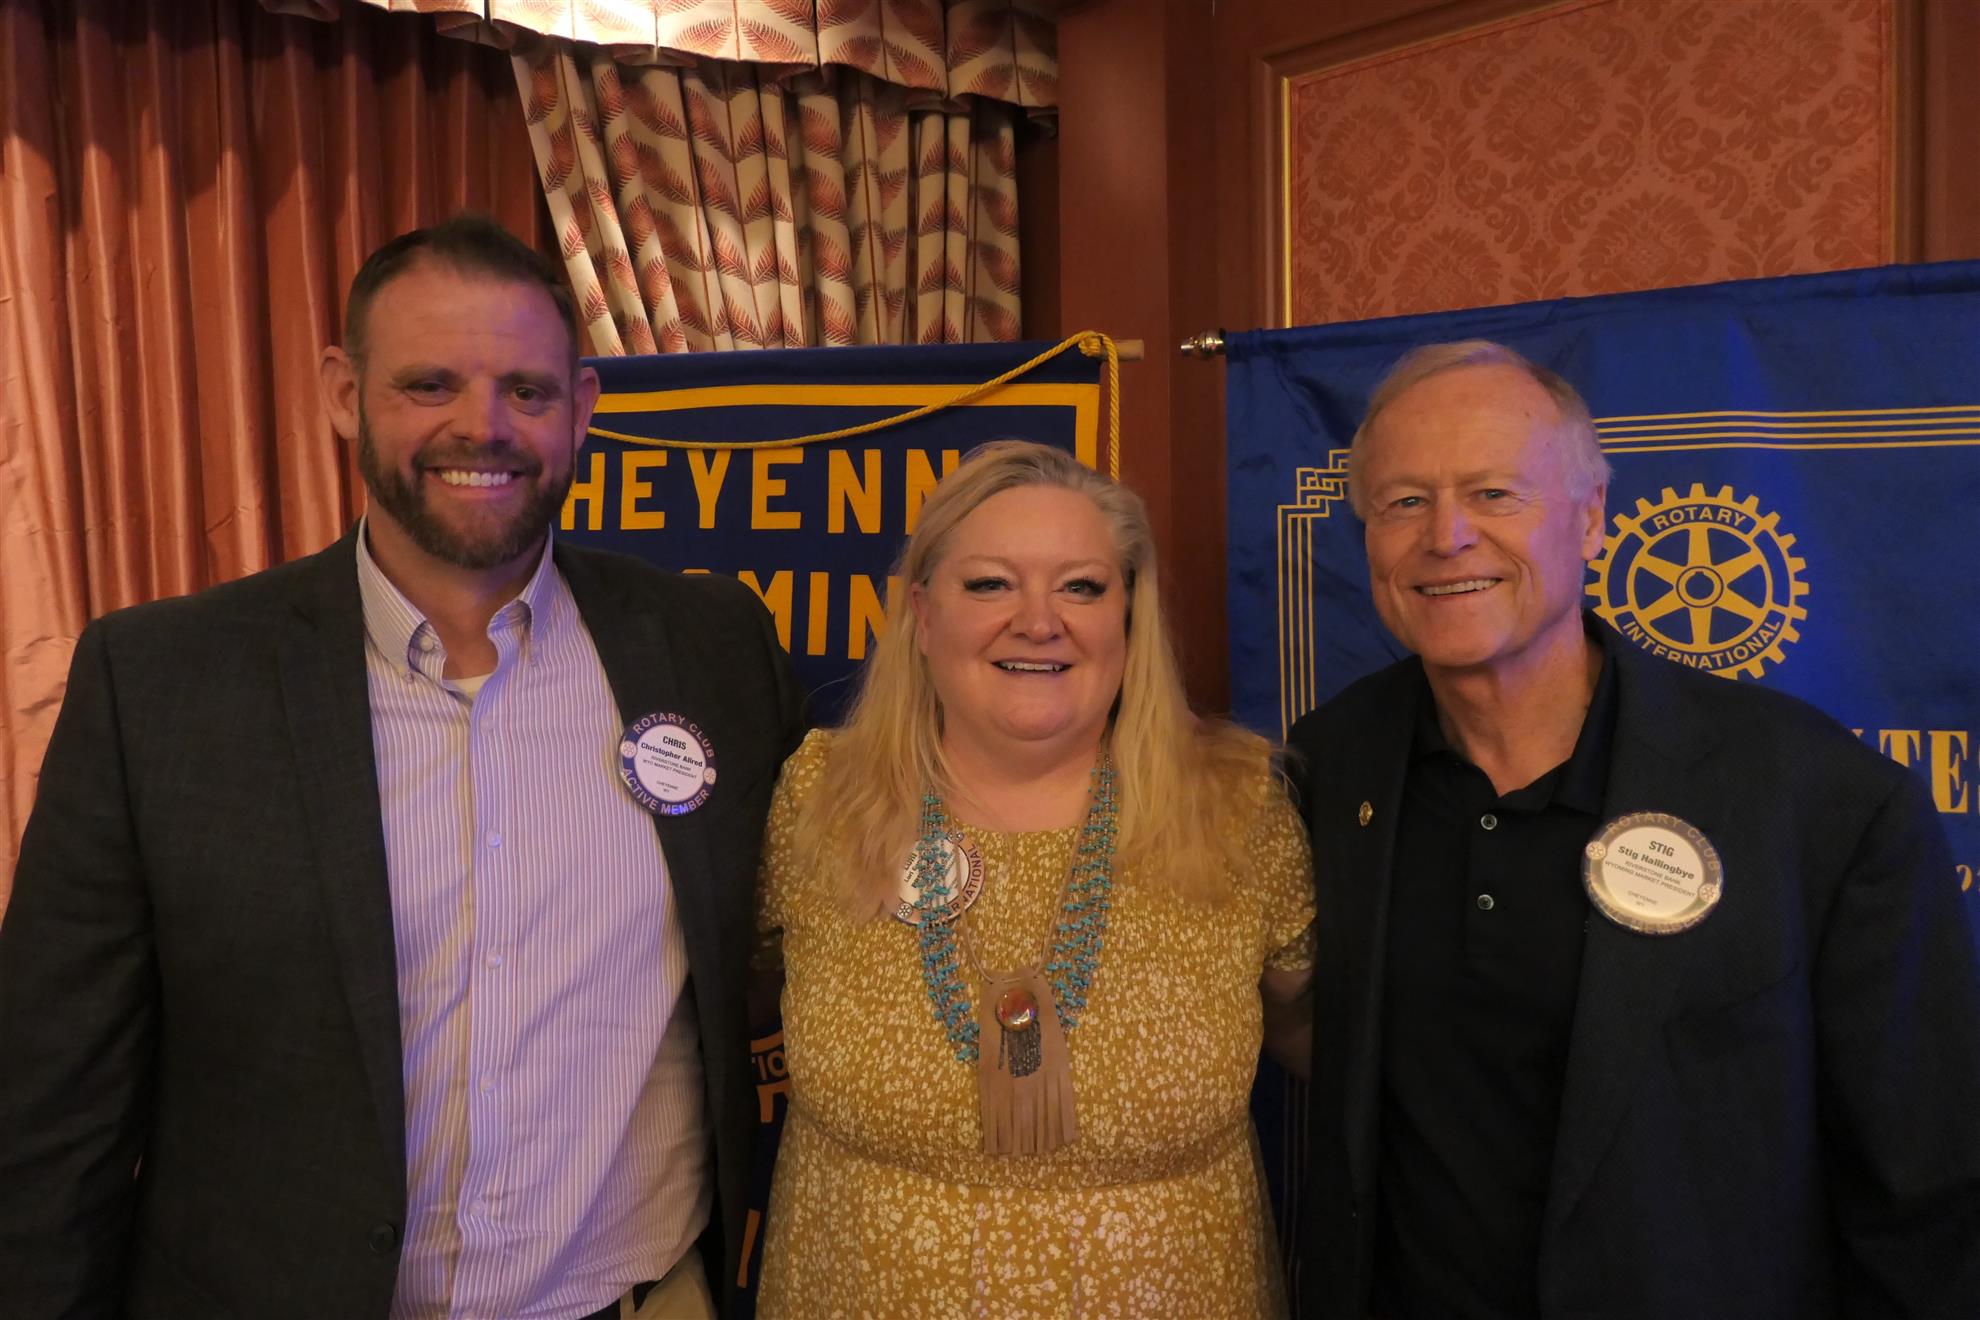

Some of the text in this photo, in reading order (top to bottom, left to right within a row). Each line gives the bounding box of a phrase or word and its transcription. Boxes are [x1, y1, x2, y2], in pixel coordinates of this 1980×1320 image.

[1652, 506, 1747, 530] ROTARY
[681, 569, 897, 660] MIN
[1622, 620, 1781, 669] INTERNATIONAL
[633, 712, 715, 758] ROTARY CLUB
[662, 736, 687, 750] CHRIS
[640, 742, 703, 768] Christopher Allred
[623, 768, 710, 815] ACTIVE MEMBER
[1606, 812, 1719, 871] ROTARY CLUB
[1648, 840, 1675, 858] STIG
[1618, 846, 1695, 880] Stig Hallingbye
[1661, 881, 1695, 898] PRESIDENT
